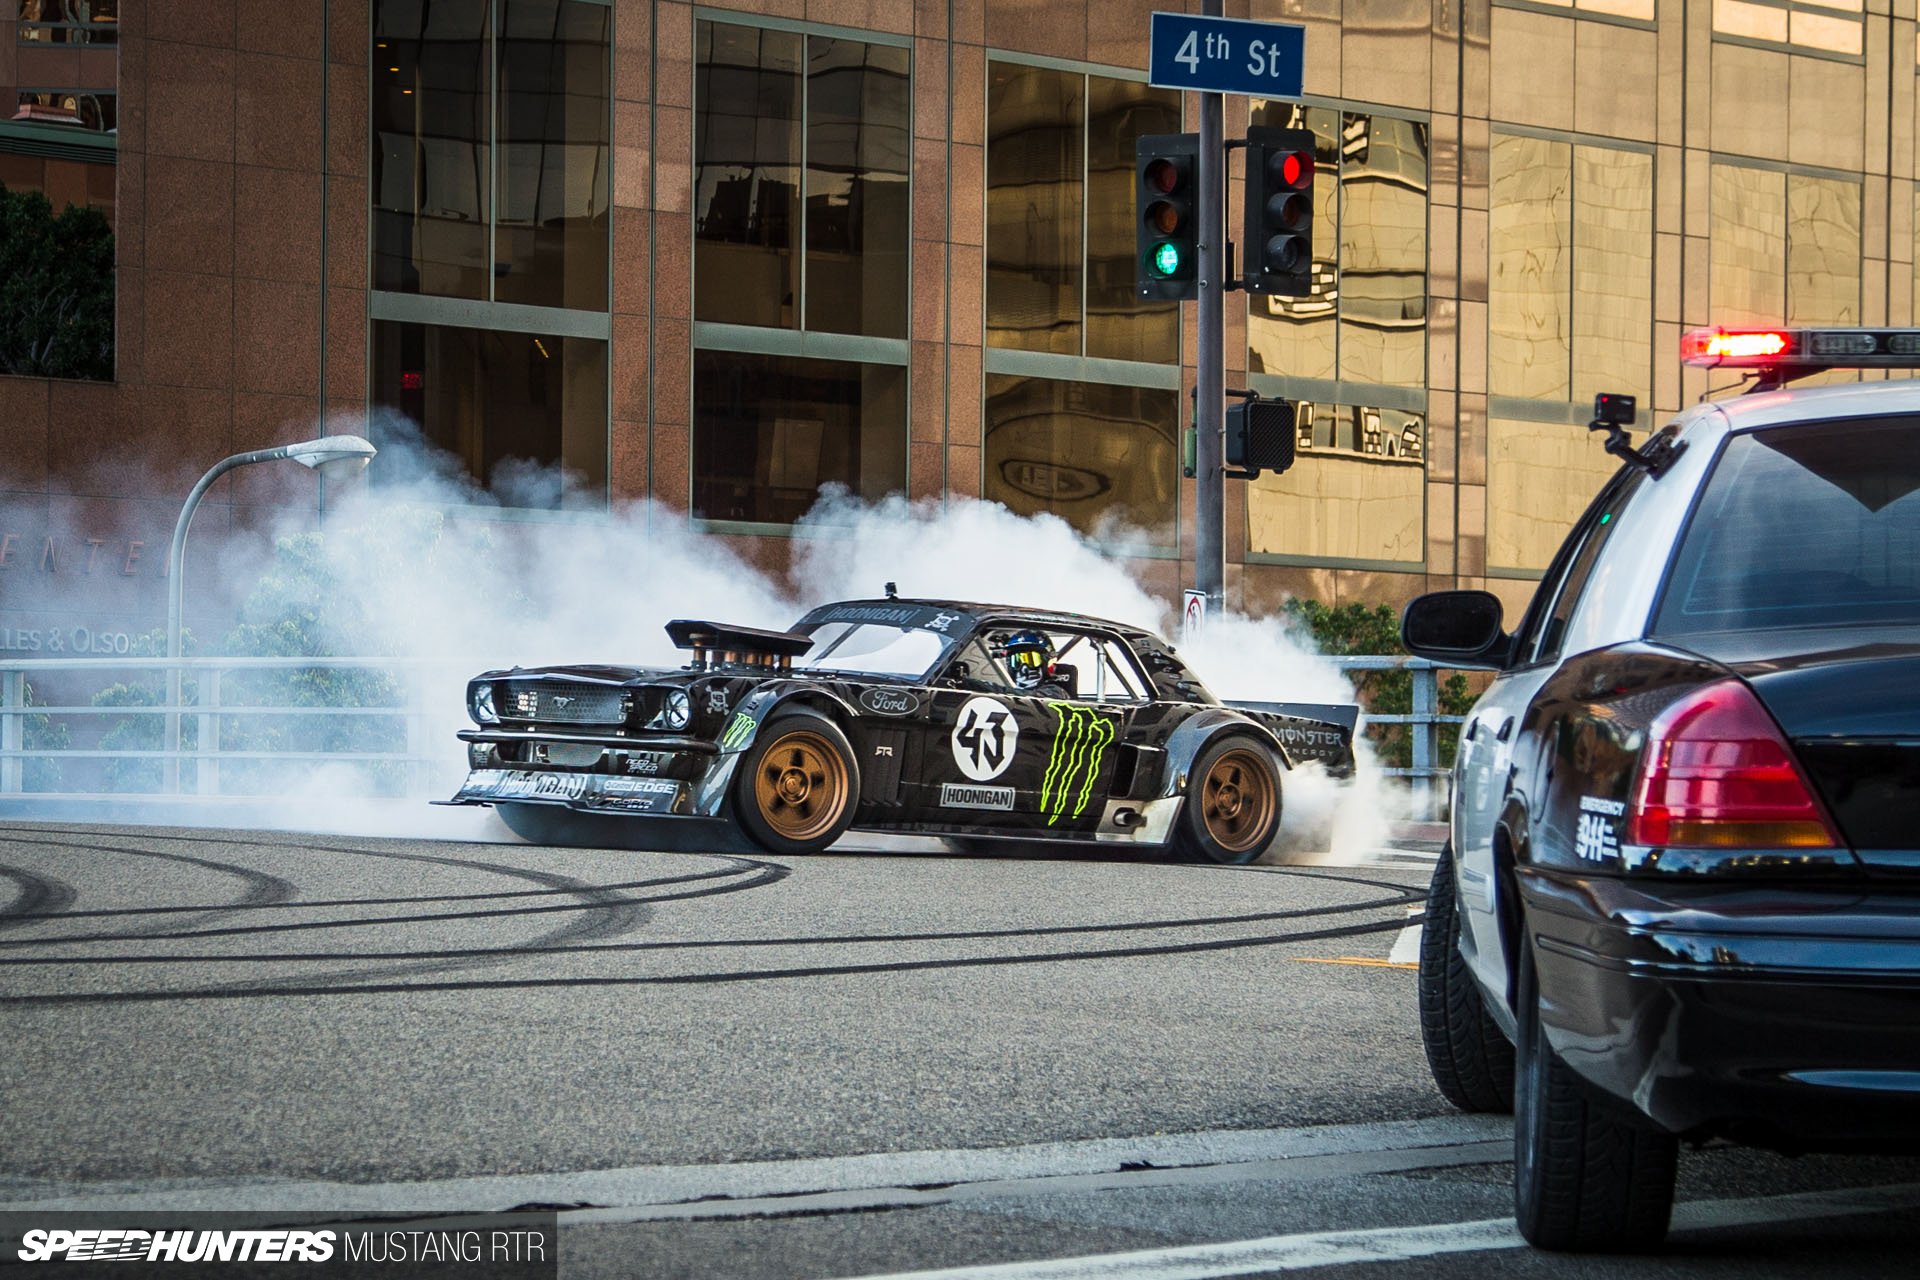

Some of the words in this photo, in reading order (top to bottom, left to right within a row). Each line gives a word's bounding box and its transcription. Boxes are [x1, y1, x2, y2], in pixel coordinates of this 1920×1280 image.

[1174, 30, 1231, 75] 4th
[1247, 39, 1281, 78] St
[48, 626, 65, 652] &
[871, 690, 908, 711] Ford
[633, 781, 674, 794] EDGE
